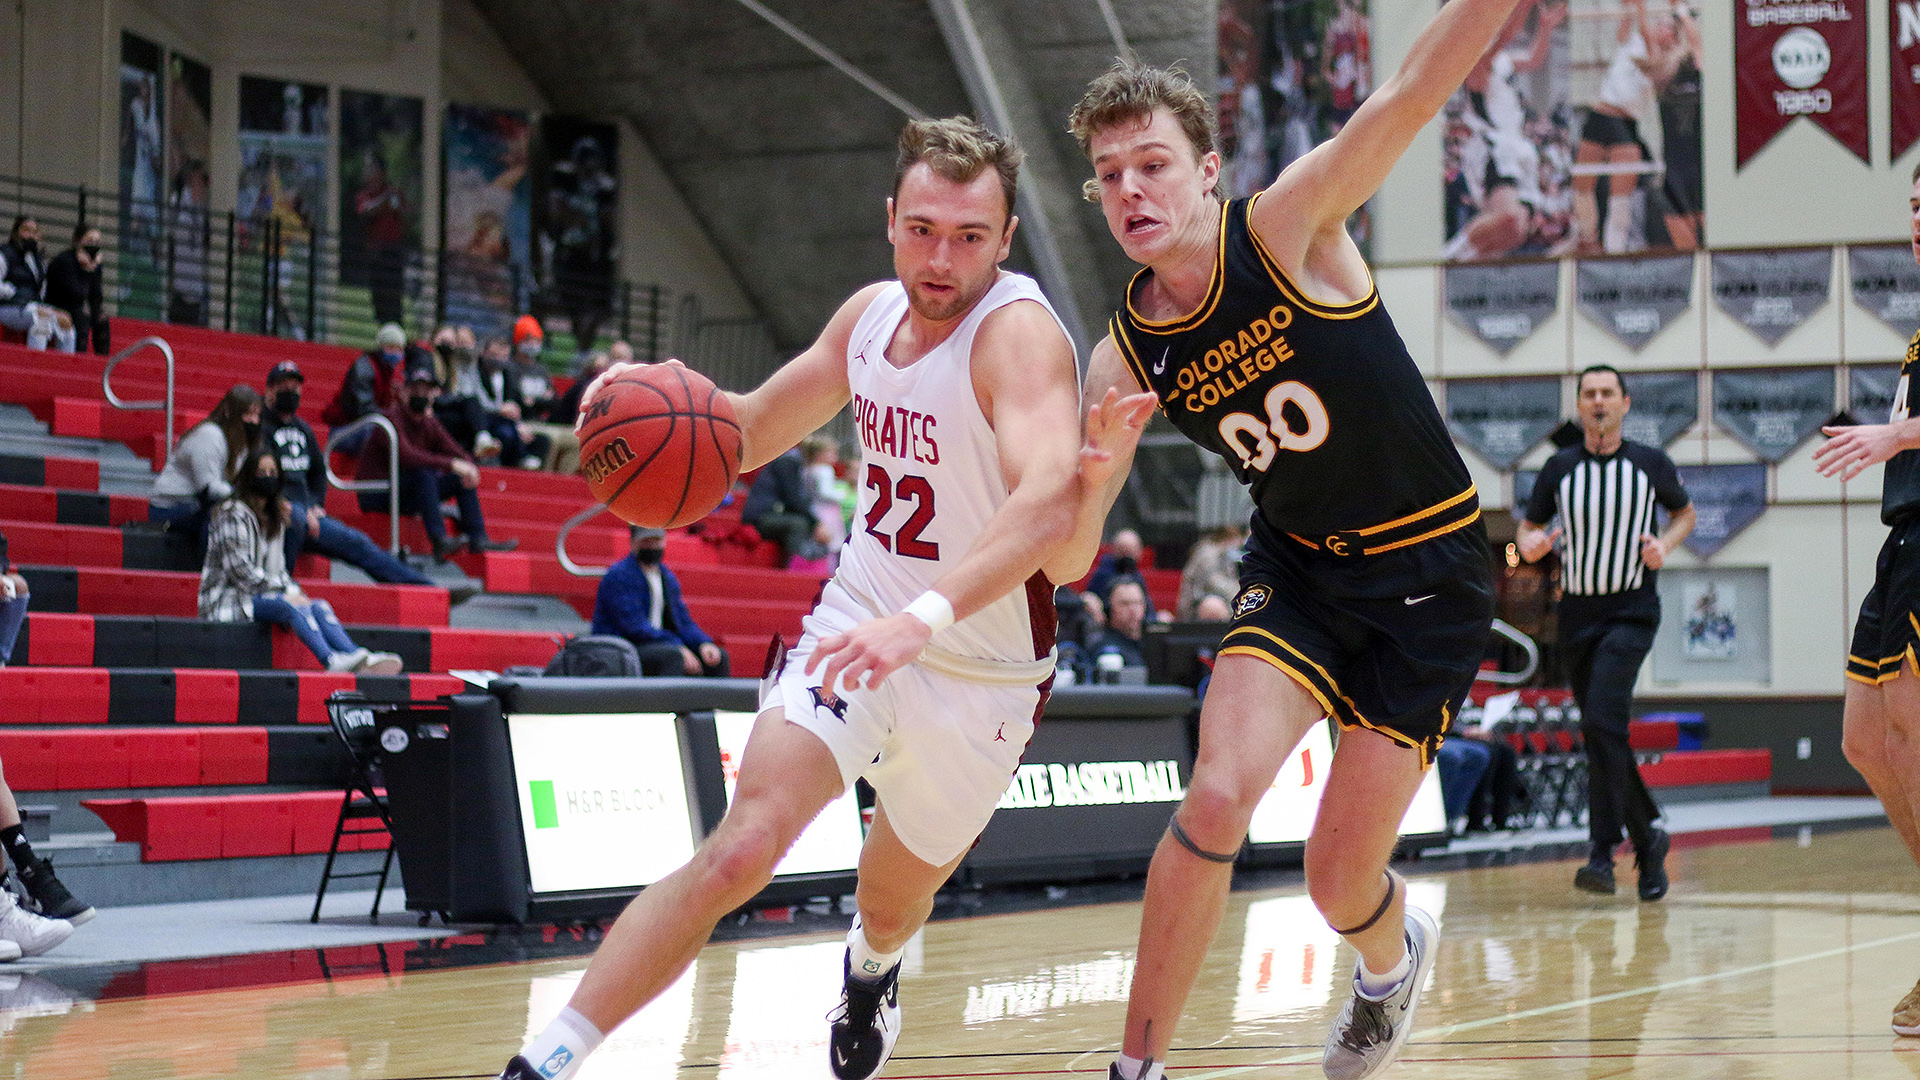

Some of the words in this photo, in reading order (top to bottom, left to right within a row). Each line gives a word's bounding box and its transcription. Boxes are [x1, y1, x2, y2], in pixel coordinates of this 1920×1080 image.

[1747, 2, 1852, 27] BASEBALL
[1185, 336, 1295, 413] COLLEGE
[855, 393, 940, 465] PIRATES
[1218, 380, 1330, 473] 00
[865, 463, 940, 562] 22
[566, 790, 604, 813] H&R
[610, 788, 669, 812] BLOCK
[996, 763, 1053, 810] ATE
[1047, 758, 1188, 807] BASKETBALL
